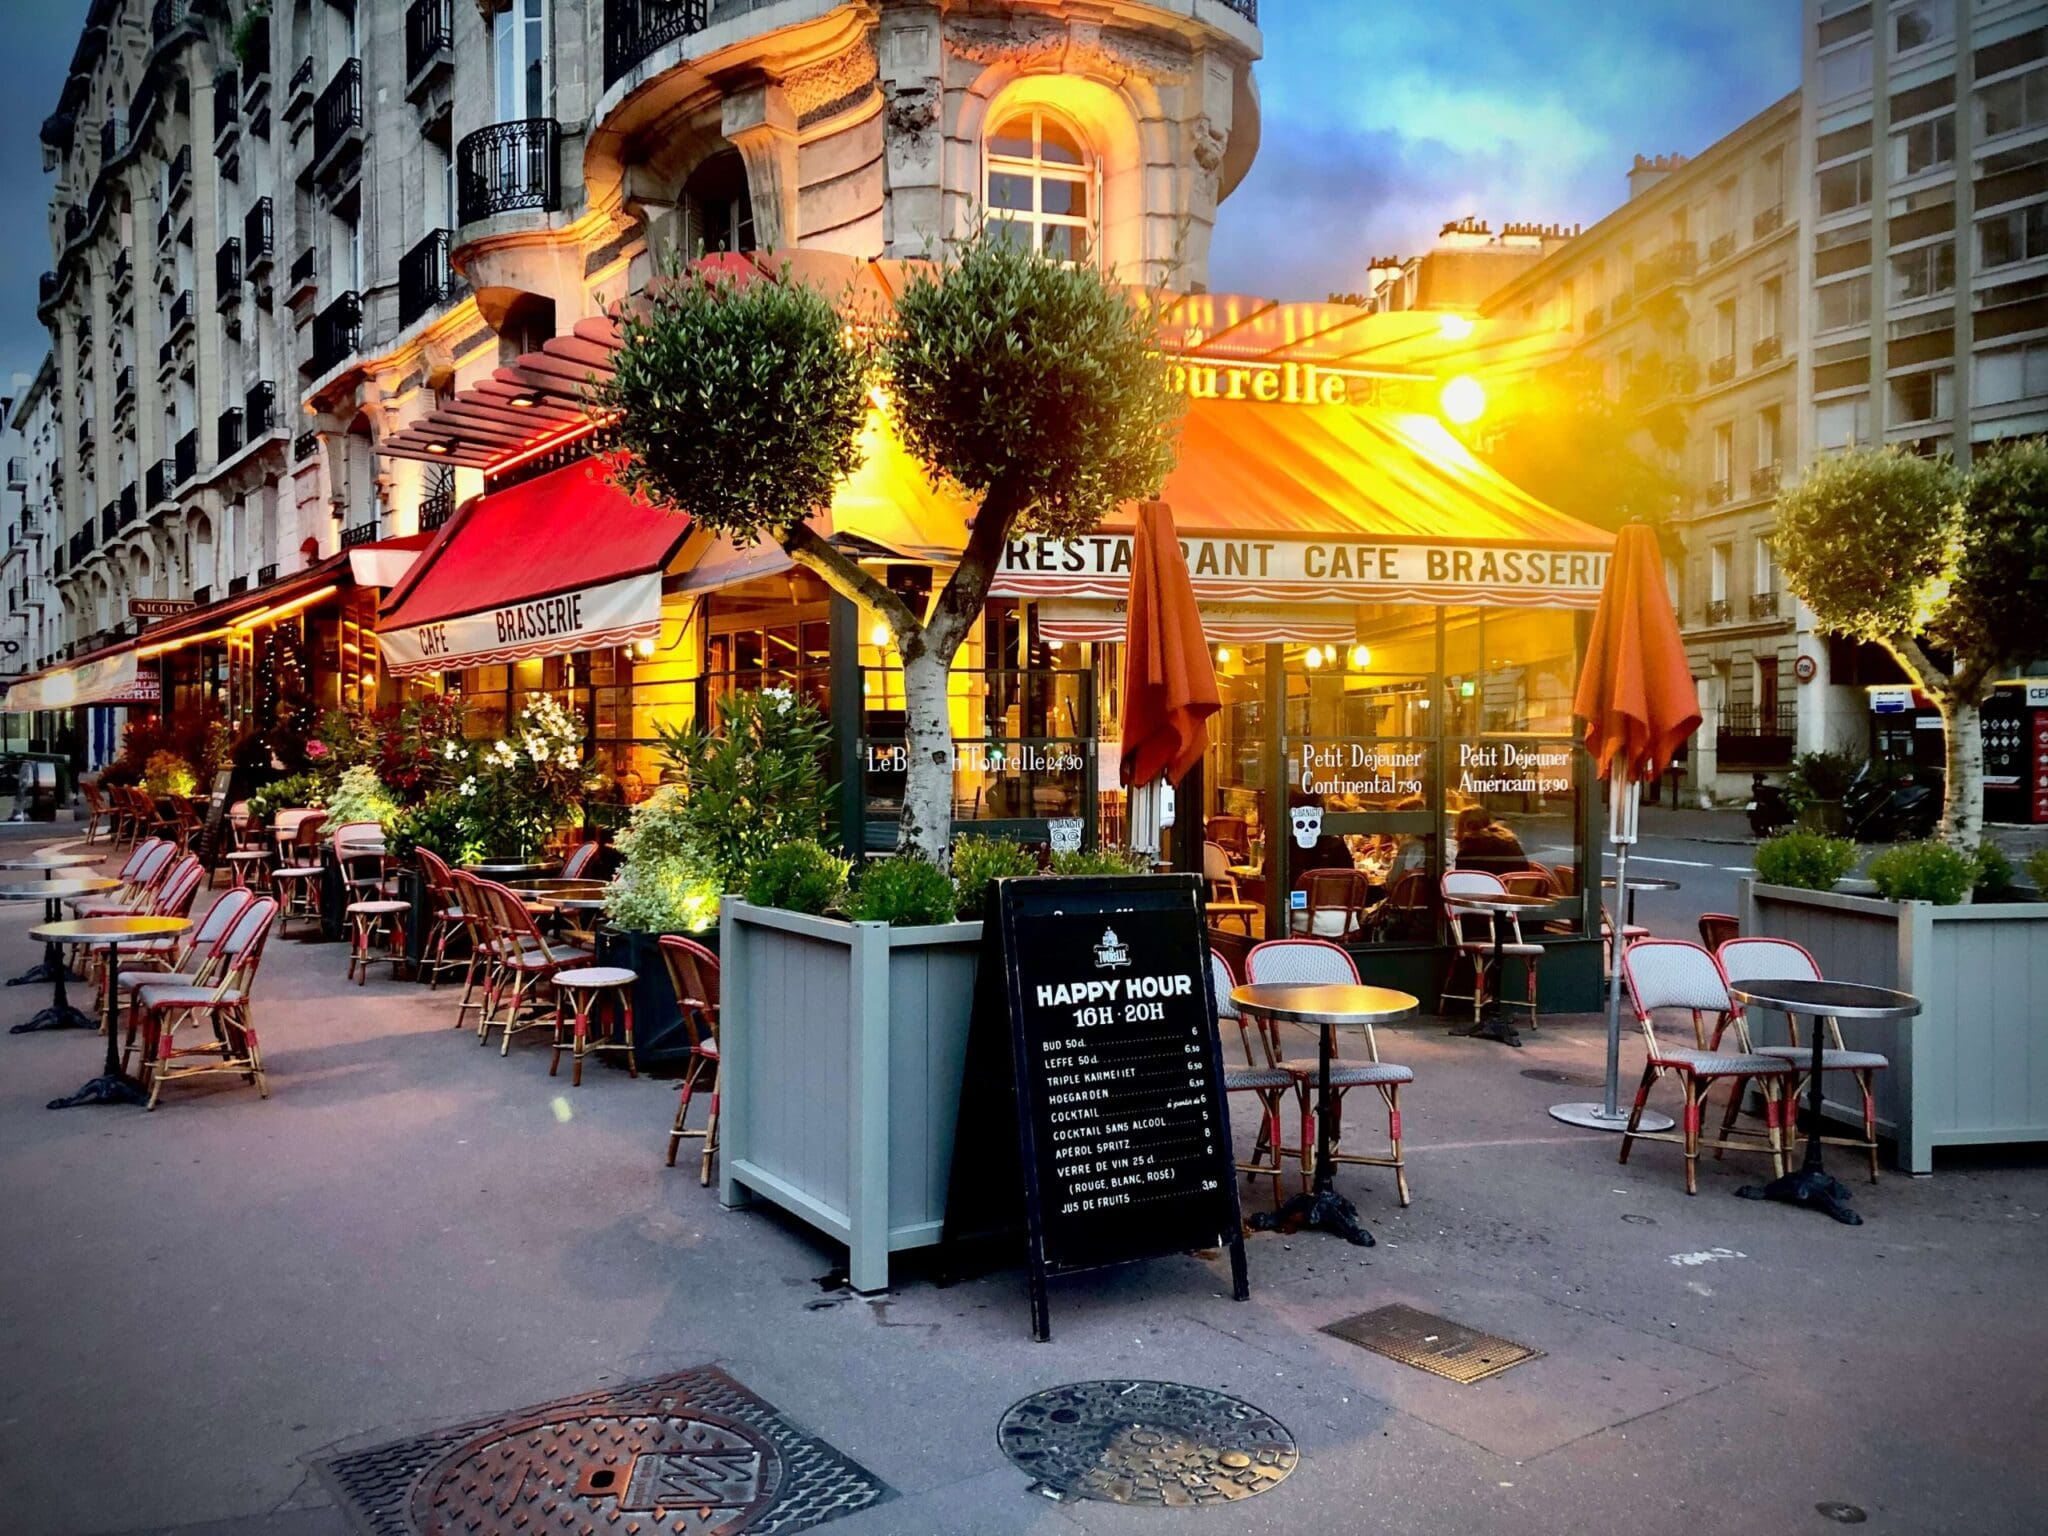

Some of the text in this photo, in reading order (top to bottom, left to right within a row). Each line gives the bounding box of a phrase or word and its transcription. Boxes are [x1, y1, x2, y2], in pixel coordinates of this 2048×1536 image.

[1165, 362, 1347, 404] ourelle
[1006, 536, 1611, 585] RESTAANT CAFE BRASSERI
[419, 594, 583, 655] CAFE BRASSERIE
[868, 747, 890, 772] Le
[968, 745, 1045, 773] Tourelle
[1303, 744, 1422, 771] Petit Déjeuner
[1460, 743, 1569, 770] Petit Déjeuner
[1302, 771, 1395, 794] Continental
[1459, 770, 1536, 793] Américain
[1037, 974, 1192, 1007] HAPPY HOUR
[1073, 1002, 1164, 1027] 16H 20H
[1042, 1041, 1061, 1051] BUD
[1191, 1026, 1198, 1036] 6
[1044, 1056, 1074, 1069] LEFFE
[1047, 1073, 1080, 1086] TRIPLE
[1049, 1089, 1109, 1105] HOEGARDEN
[1051, 1108, 1100, 1123] COCKTAIL
[1200, 1093, 1207, 1103] 6
[1053, 1111, 1209, 1141] COCKTAIL SANS ALCOOL 5
[1097, 1140, 1131, 1153] SPRITZ
[1204, 1127, 1211, 1137] 8
[1057, 1163, 1092, 1178] VERRE
[1096, 1161, 1108, 1172] DE
[1112, 1158, 1129, 1169] VIN
[1206, 1145, 1213, 1155] 6
[1111, 1174, 1145, 1188] BLANC,
[1061, 1203, 1079, 1214] JUS
[1082, 1198, 1095, 1211] DE
[1097, 1193, 1131, 1208] FRUITS
